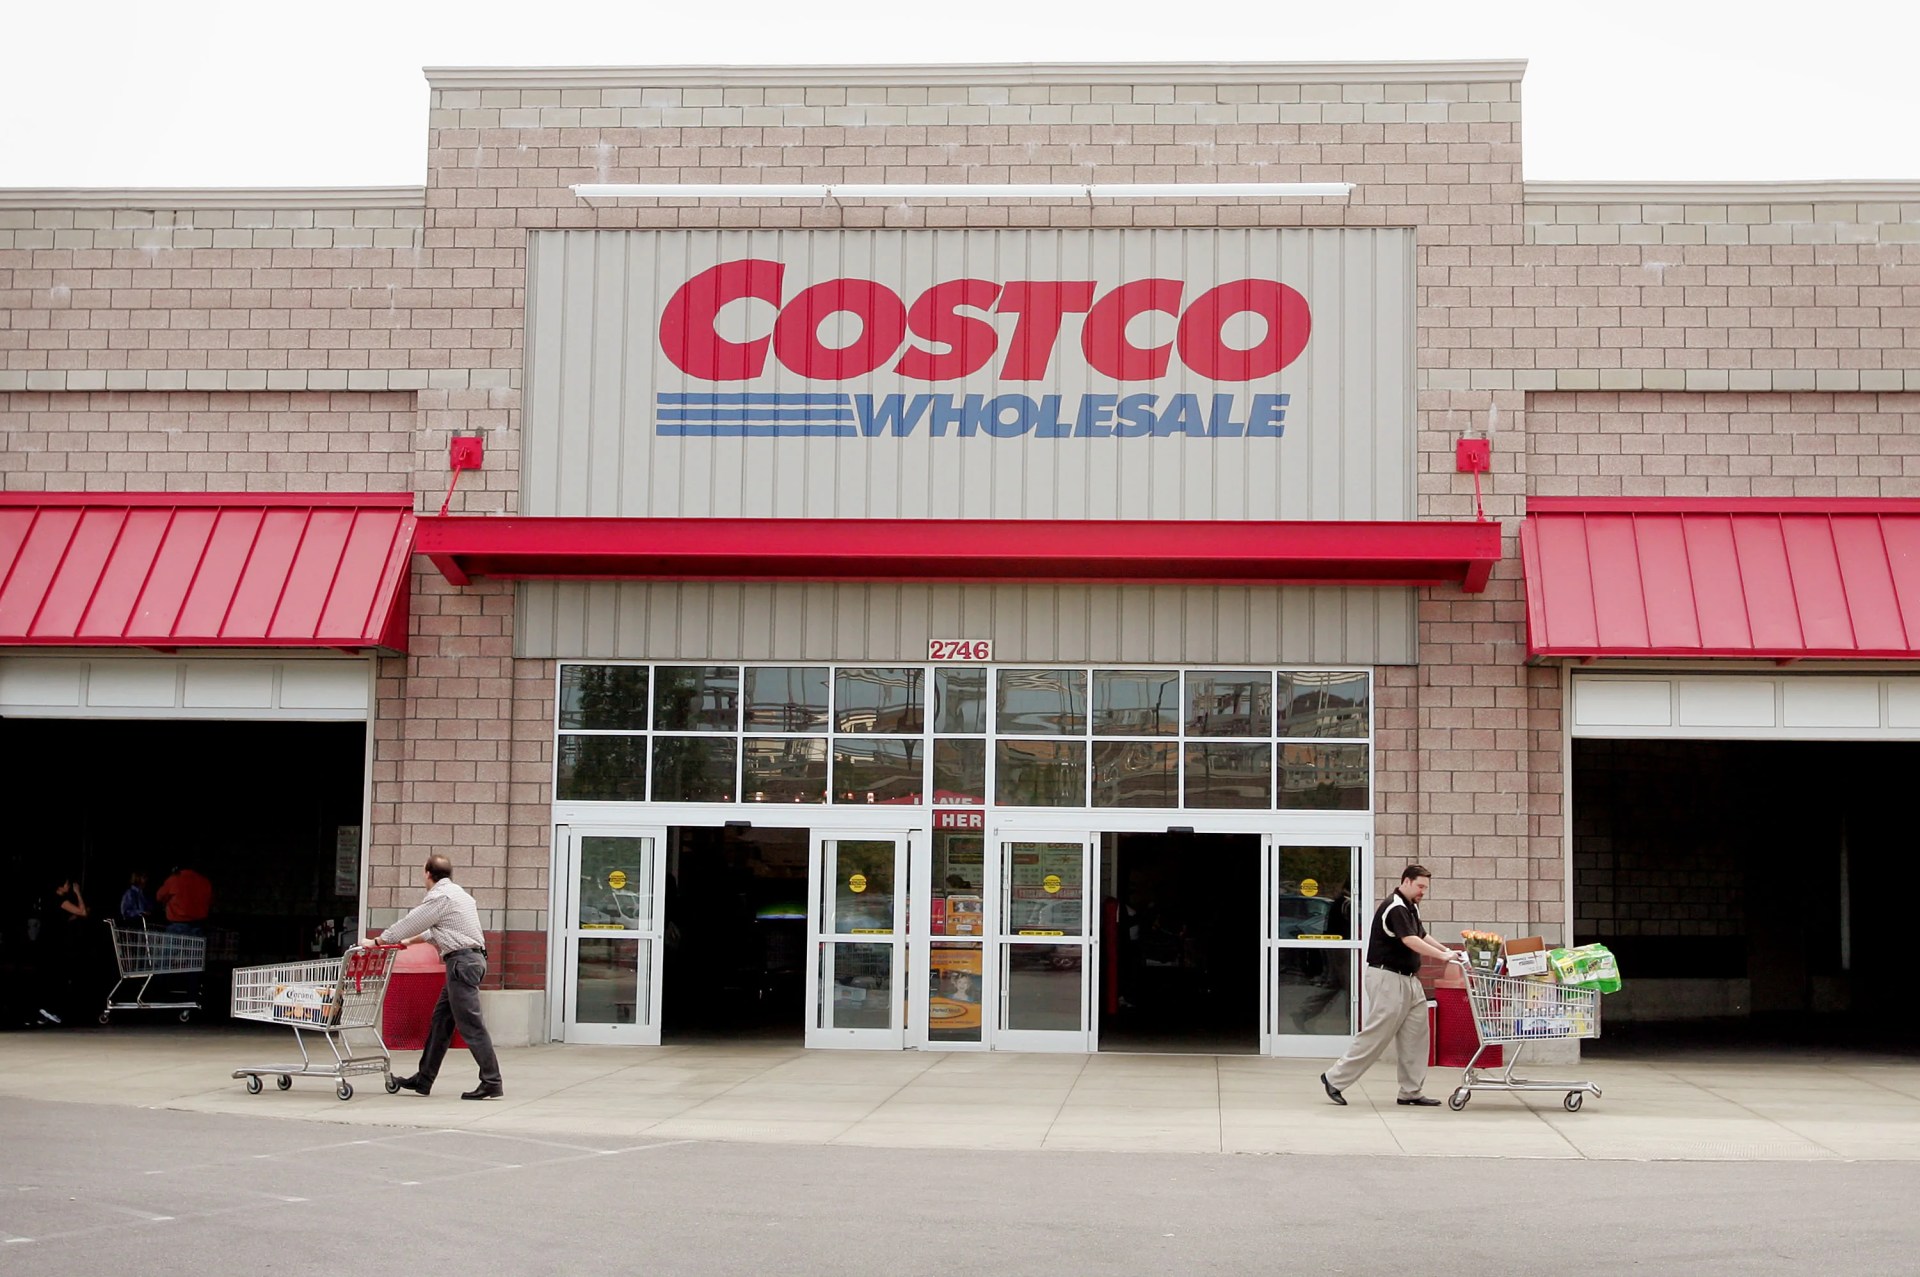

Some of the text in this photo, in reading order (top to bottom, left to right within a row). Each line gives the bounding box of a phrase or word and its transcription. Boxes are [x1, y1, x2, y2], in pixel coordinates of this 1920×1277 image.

[659, 259, 1312, 381] COSTCO
[850, 393, 1291, 438] WHOLESALE
[930, 641, 989, 660] 2746
